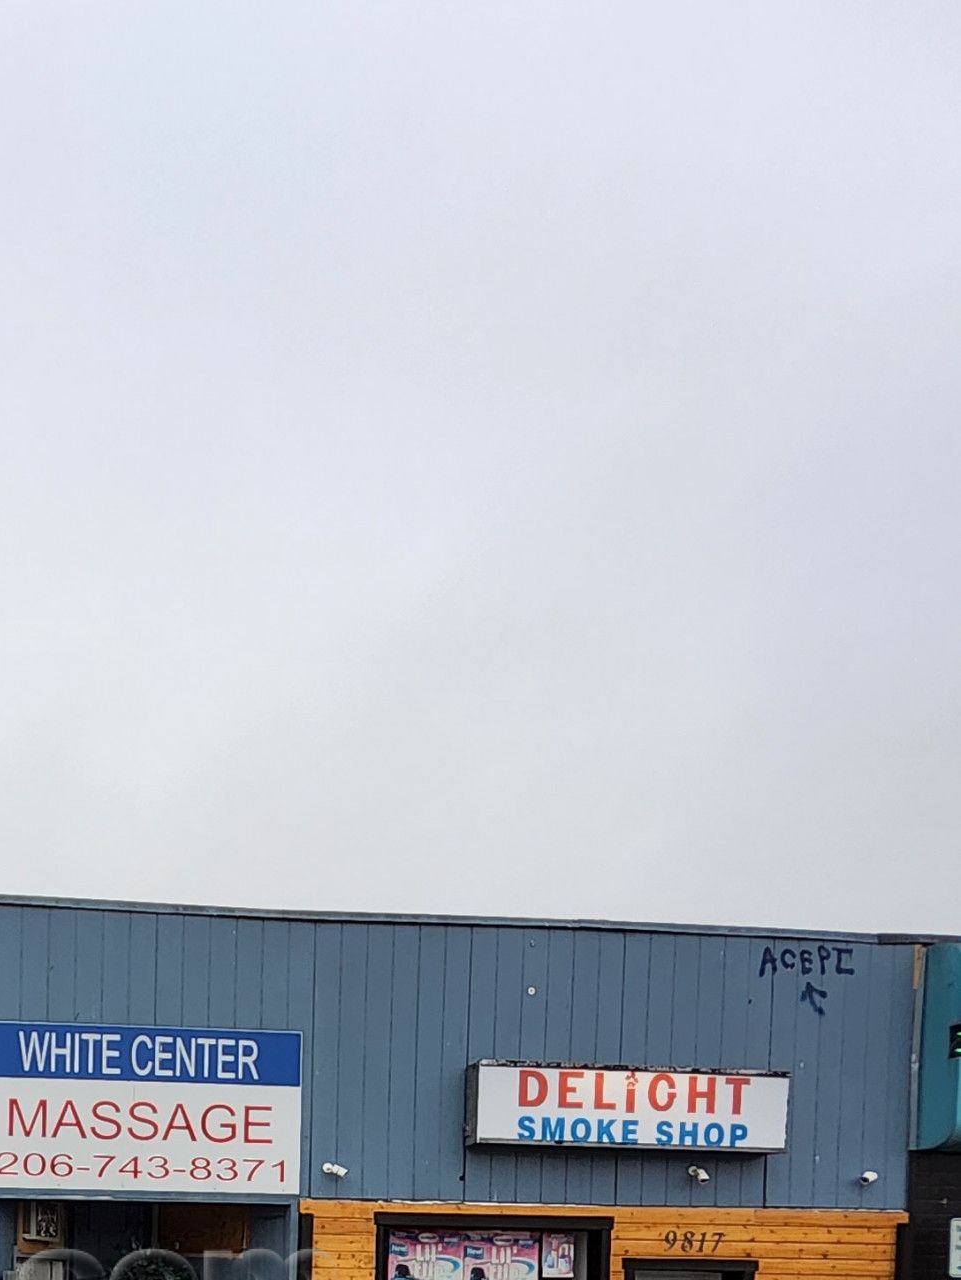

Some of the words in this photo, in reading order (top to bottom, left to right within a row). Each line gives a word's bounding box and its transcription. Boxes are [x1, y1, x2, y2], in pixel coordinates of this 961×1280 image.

[18, 1030, 122, 1076] WHITE
[131, 1034, 260, 1081] CENTER
[6, 1098, 274, 1145] MASSAGE
[517, 1115, 639, 1145] SMOKE
[655, 1120, 749, 1148] SHOP
[664, 1230, 726, 1253] 9817
